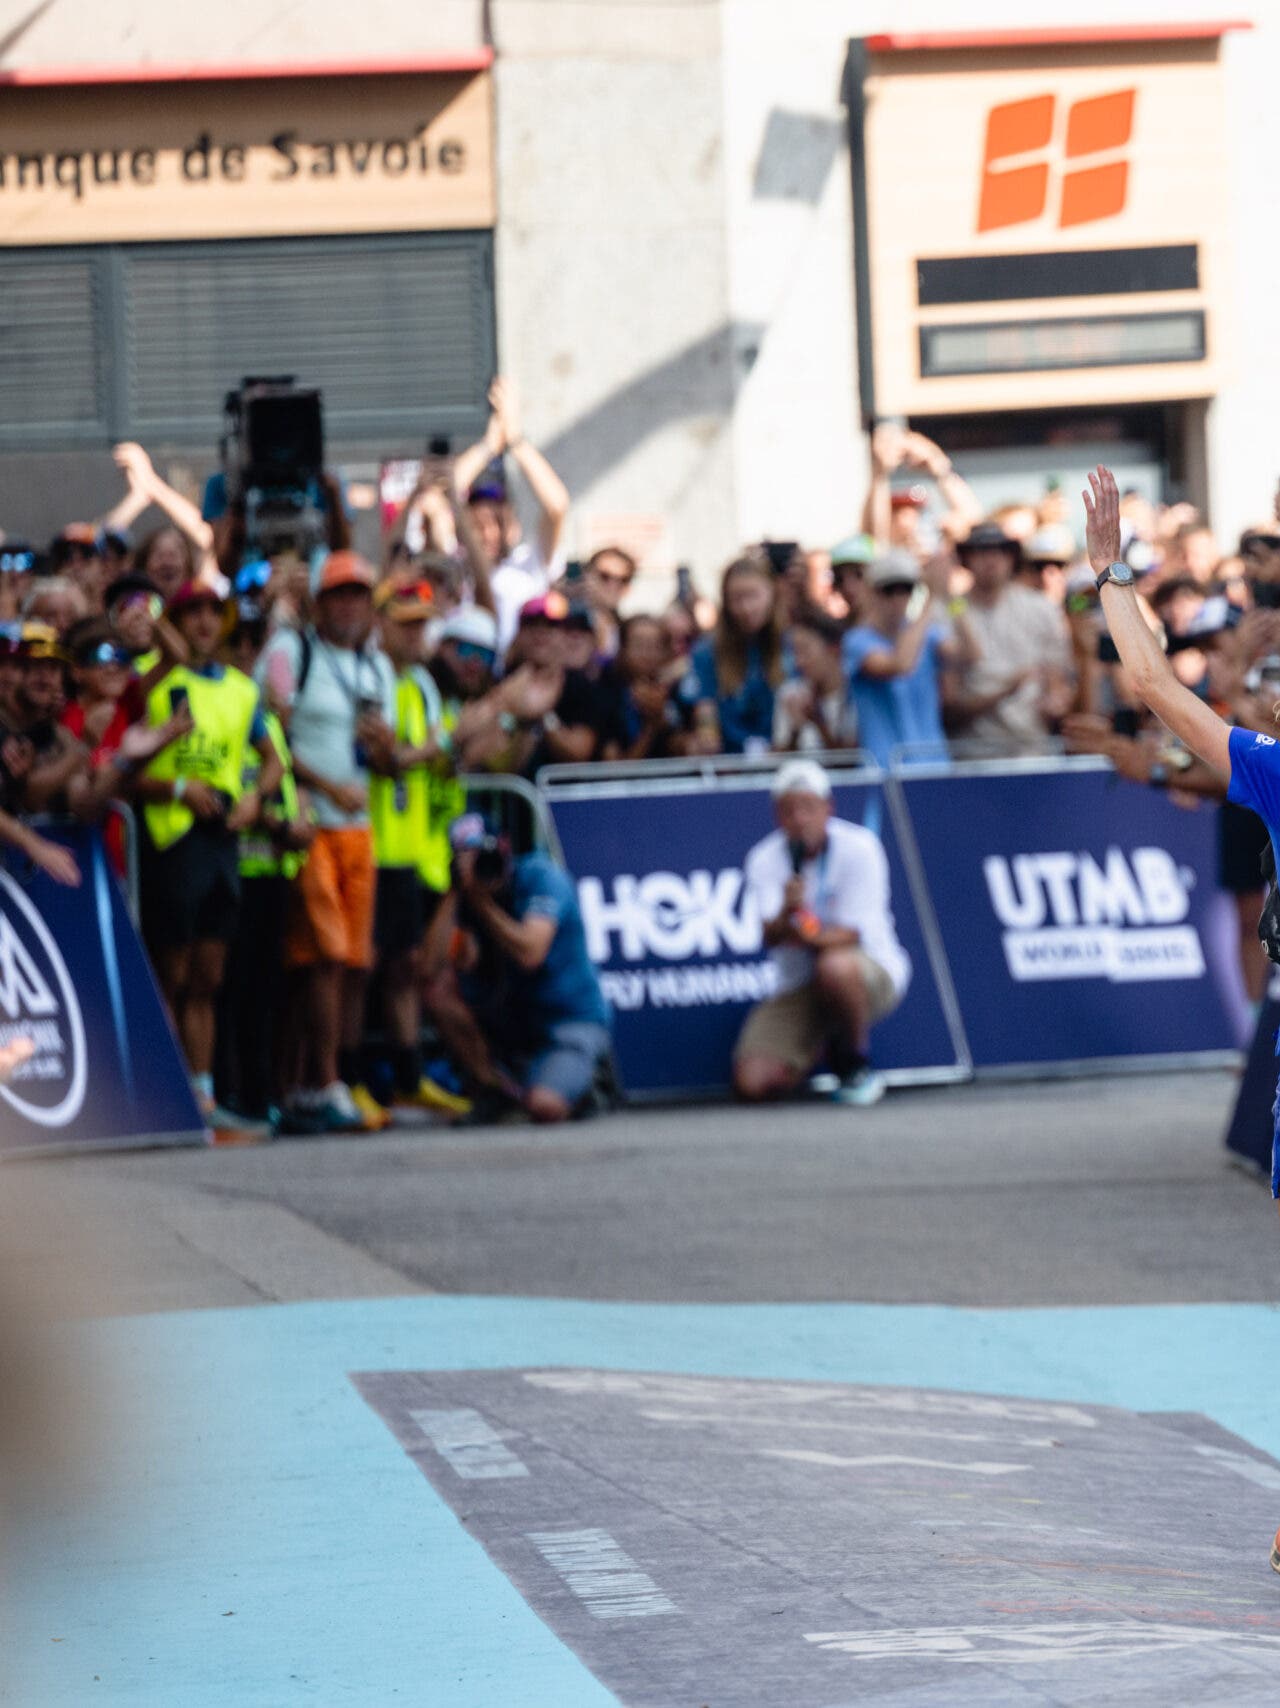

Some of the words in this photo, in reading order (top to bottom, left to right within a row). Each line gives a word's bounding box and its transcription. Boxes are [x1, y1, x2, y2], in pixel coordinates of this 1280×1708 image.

[182, 131, 249, 183] de
[270, 122, 466, 183] Savoie
[983, 845, 1190, 929] UTMB
